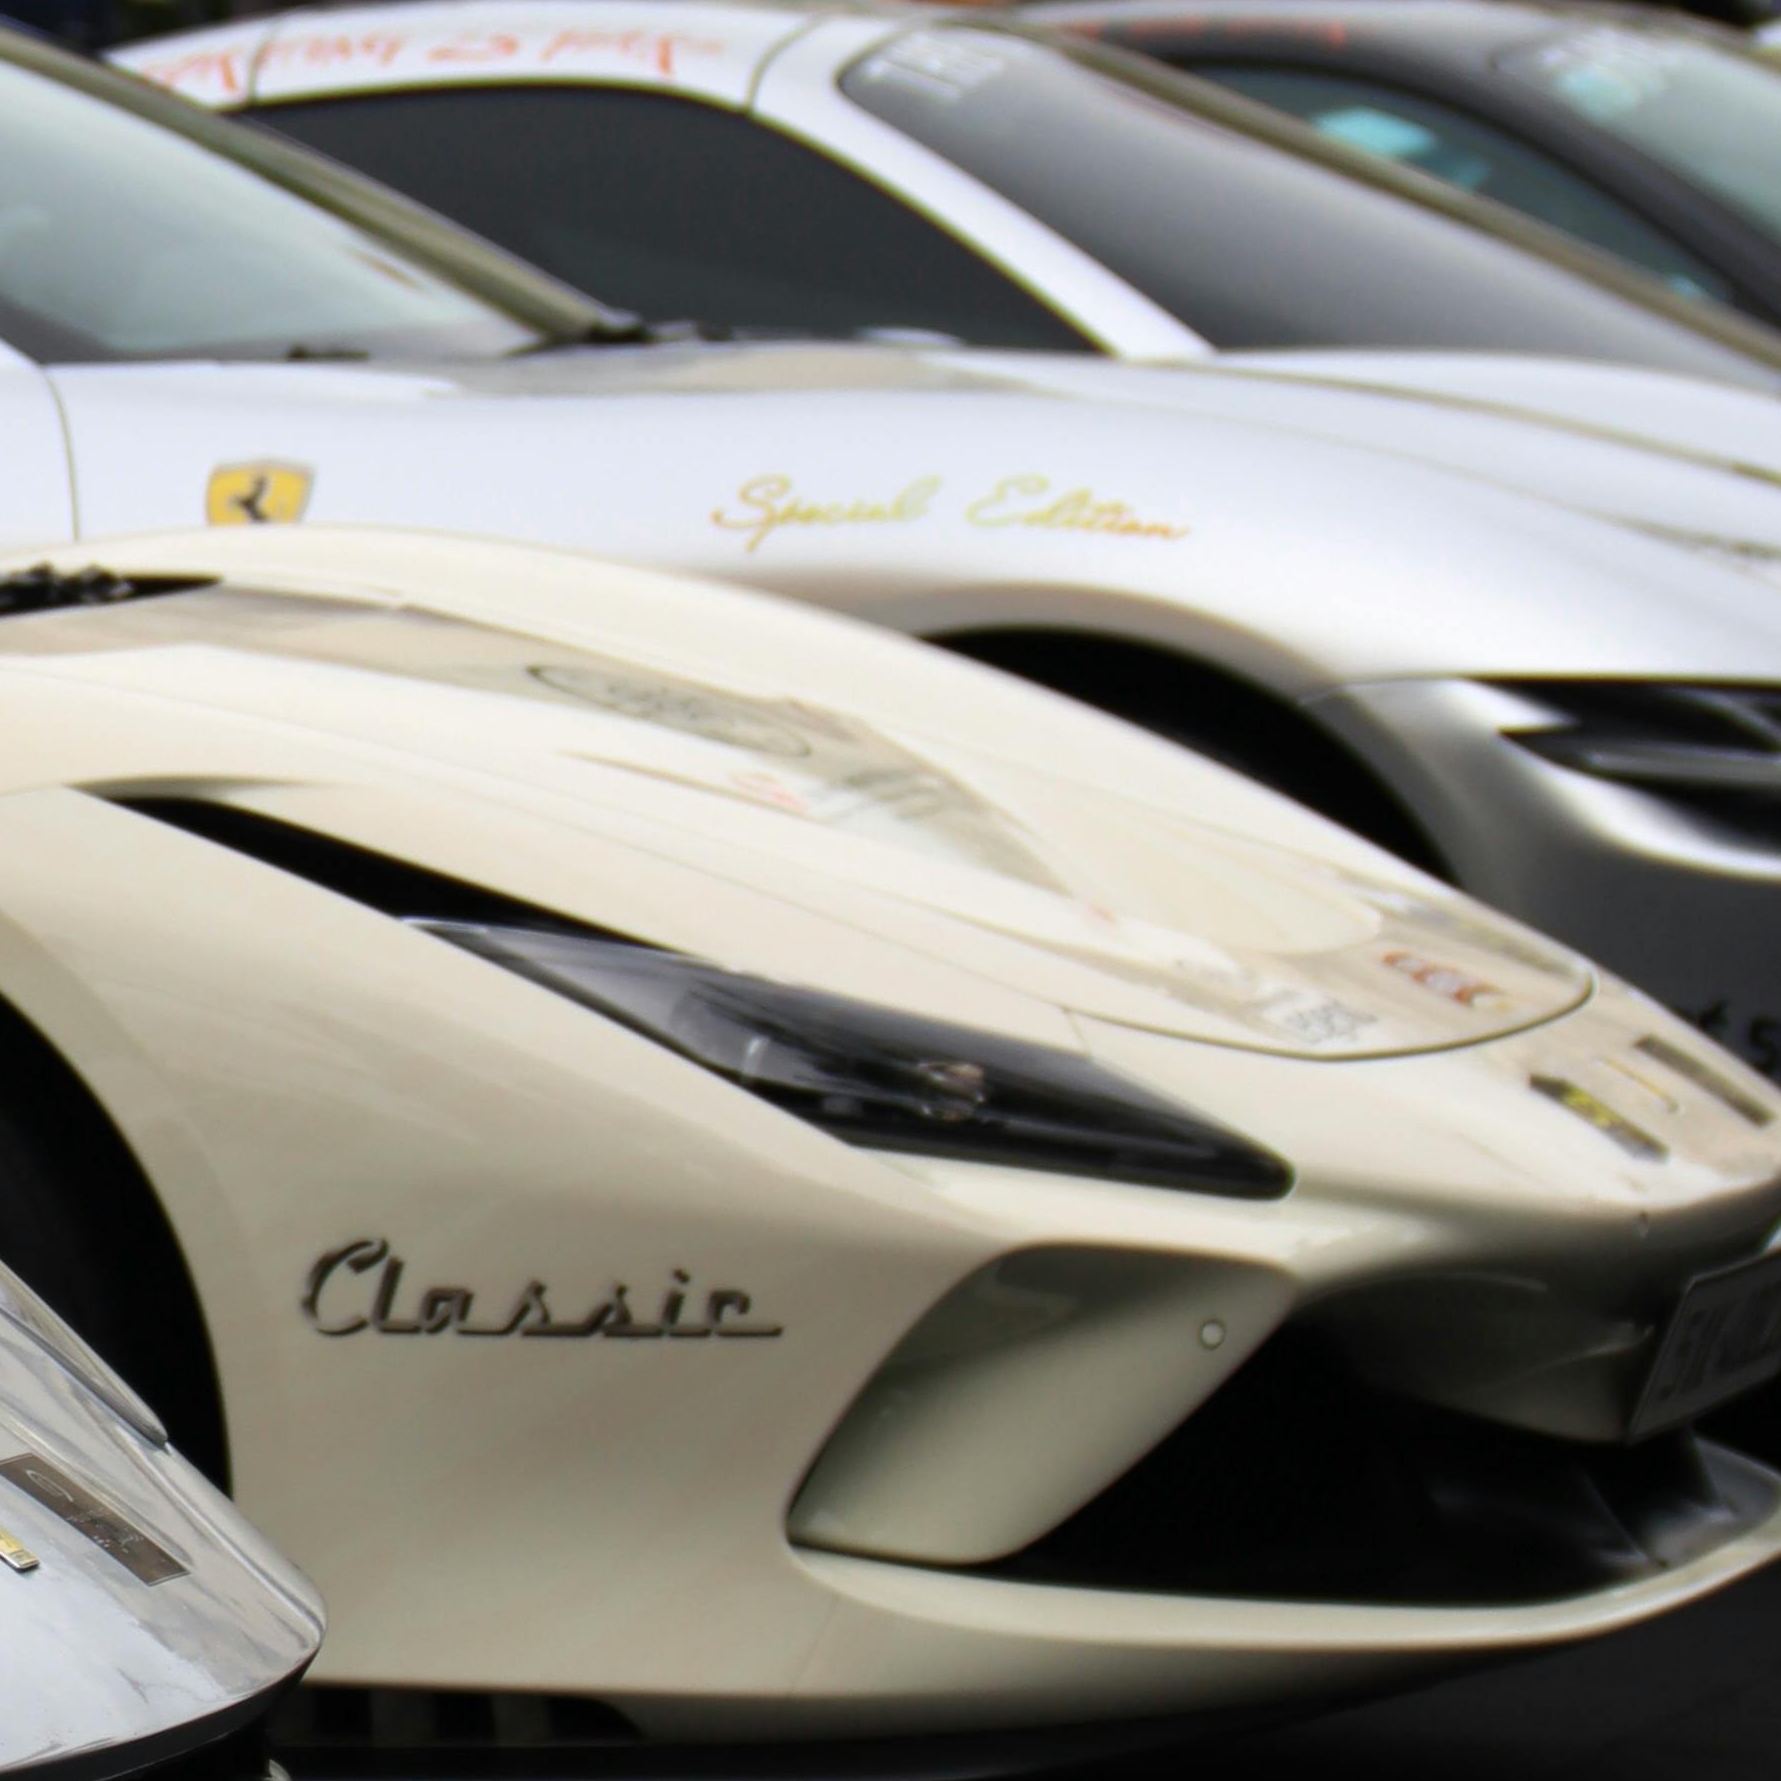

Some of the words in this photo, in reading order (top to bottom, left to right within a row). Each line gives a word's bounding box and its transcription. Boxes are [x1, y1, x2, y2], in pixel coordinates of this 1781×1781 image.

[710, 472, 944, 554] Special
[965, 472, 1192, 541] Edition
[300, 1236, 785, 1339] Classic
